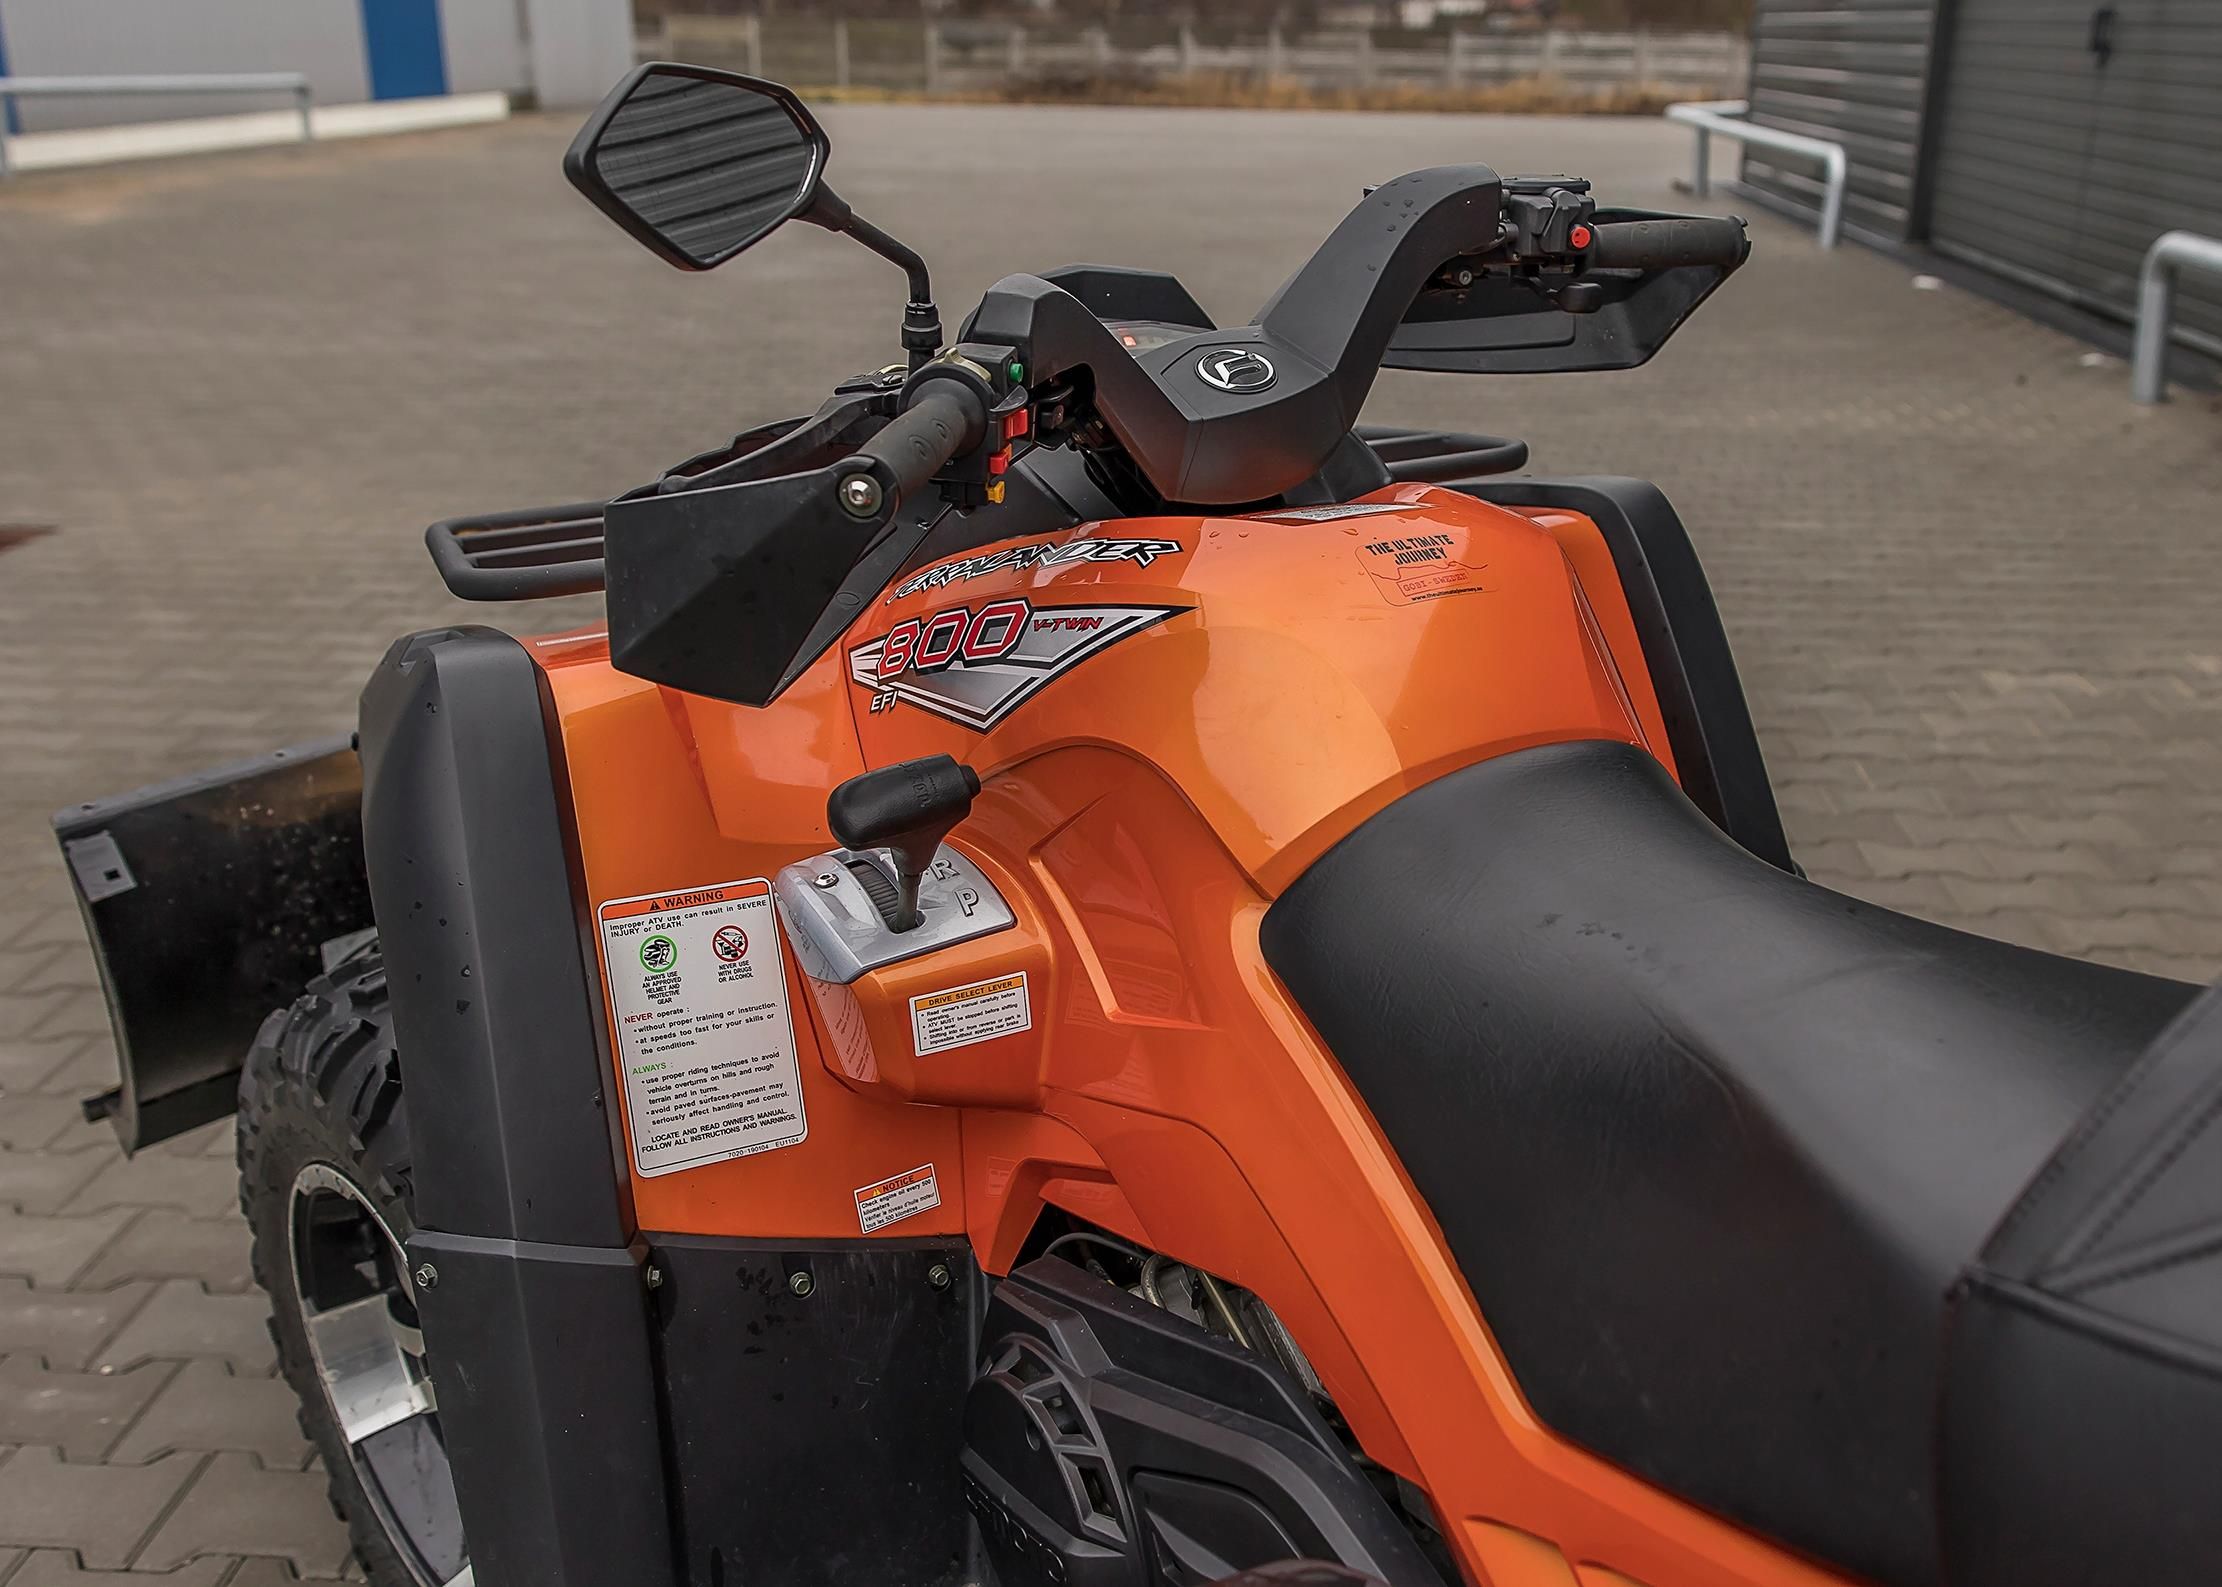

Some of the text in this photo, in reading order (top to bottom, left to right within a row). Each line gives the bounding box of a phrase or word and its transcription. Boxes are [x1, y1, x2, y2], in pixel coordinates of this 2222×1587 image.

[1366, 534, 1454, 555] THE ULTIMATE
[1395, 547, 1447, 565] JOURNEY
[878, 597, 1104, 683] 800 V-TWIN
[870, 690, 899, 713] EFI
[930, 859, 960, 881] R
[664, 891, 723, 908] WARNING
[954, 888, 979, 917] P
[610, 920, 644, 931] Improper
[649, 917, 663, 925] ATV
[702, 908, 723, 916] result
[737, 900, 766, 910] SEVERE
[611, 928, 639, 937] INJURY
[656, 922, 684, 930] DEATH.
[652, 977, 681, 987] APPROVED
[729, 973, 753, 981] ALCOHOL
[646, 986, 668, 994] HELMET
[648, 990, 679, 1000] PROTECTIVE
[929, 981, 1012, 1005] DRIVE SELECT LEVER
[942, 1005, 959, 1013] owner's
[980, 996, 999, 1004] carefully
[965, 1012, 983, 1020] stopped
[1001, 1003, 1018, 1011] shifting
[625, 1013, 653, 1024] NEVER
[657, 1008, 684, 1018] operate
[638, 1022, 665, 1033] without
[669, 1019, 692, 1029] proper
[696, 1012, 723, 1022] training
[738, 1002, 777, 1014] instruction.
[928, 1014, 949, 1022] operating.
[651, 1033, 676, 1043] speeds
[695, 1025, 709, 1033] fast
[725, 1020, 742, 1028] your
[745, 1014, 764, 1024] skills
[930, 1036, 954, 1045] impossible
[975, 1026, 993, 1035] applying
[930, 1032, 947, 1040] Shifting
[657, 1041, 697, 1052] conditions.
[632, 1063, 666, 1075] ALWAYS
[662, 1072, 685, 1082] proper
[688, 1066, 708, 1075] riding
[711, 1058, 748, 1070] techniques
[762, 1052, 779, 1061] avoid
[647, 1085, 671, 1094] vehicle
[675, 1077, 707, 1088] overturns
[722, 1071, 736, 1079] hills
[740, 1067, 751, 1075] and
[755, 1064, 774, 1073] rough
[649, 1095, 671, 1104] terrain
[675, 1091, 687, 1099] and
[700, 1086, 719, 1094] turns.
[651, 1082, 783, 1115] avoid paved surfaces-pavement may
[652, 1092, 789, 1125] seriously affect handling and control.
[642, 1114, 796, 1153] FOLLOW ALL INSTRUCTIONS AND WARNINGS.
[651, 1109, 786, 1143] LOCATE AND READ OWNER'S MANUAL.
[775, 1138, 799, 1147] EU1104
[883, 1175, 914, 1192] NOTICE
[862, 1199, 877, 1208] Check
[880, 1193, 896, 1202] engine
[907, 1183, 920, 1193] every
[888, 1205, 903, 1213] niveau
[920, 1193, 934, 1201] moteur
[863, 1203, 890, 1215] kilometers
